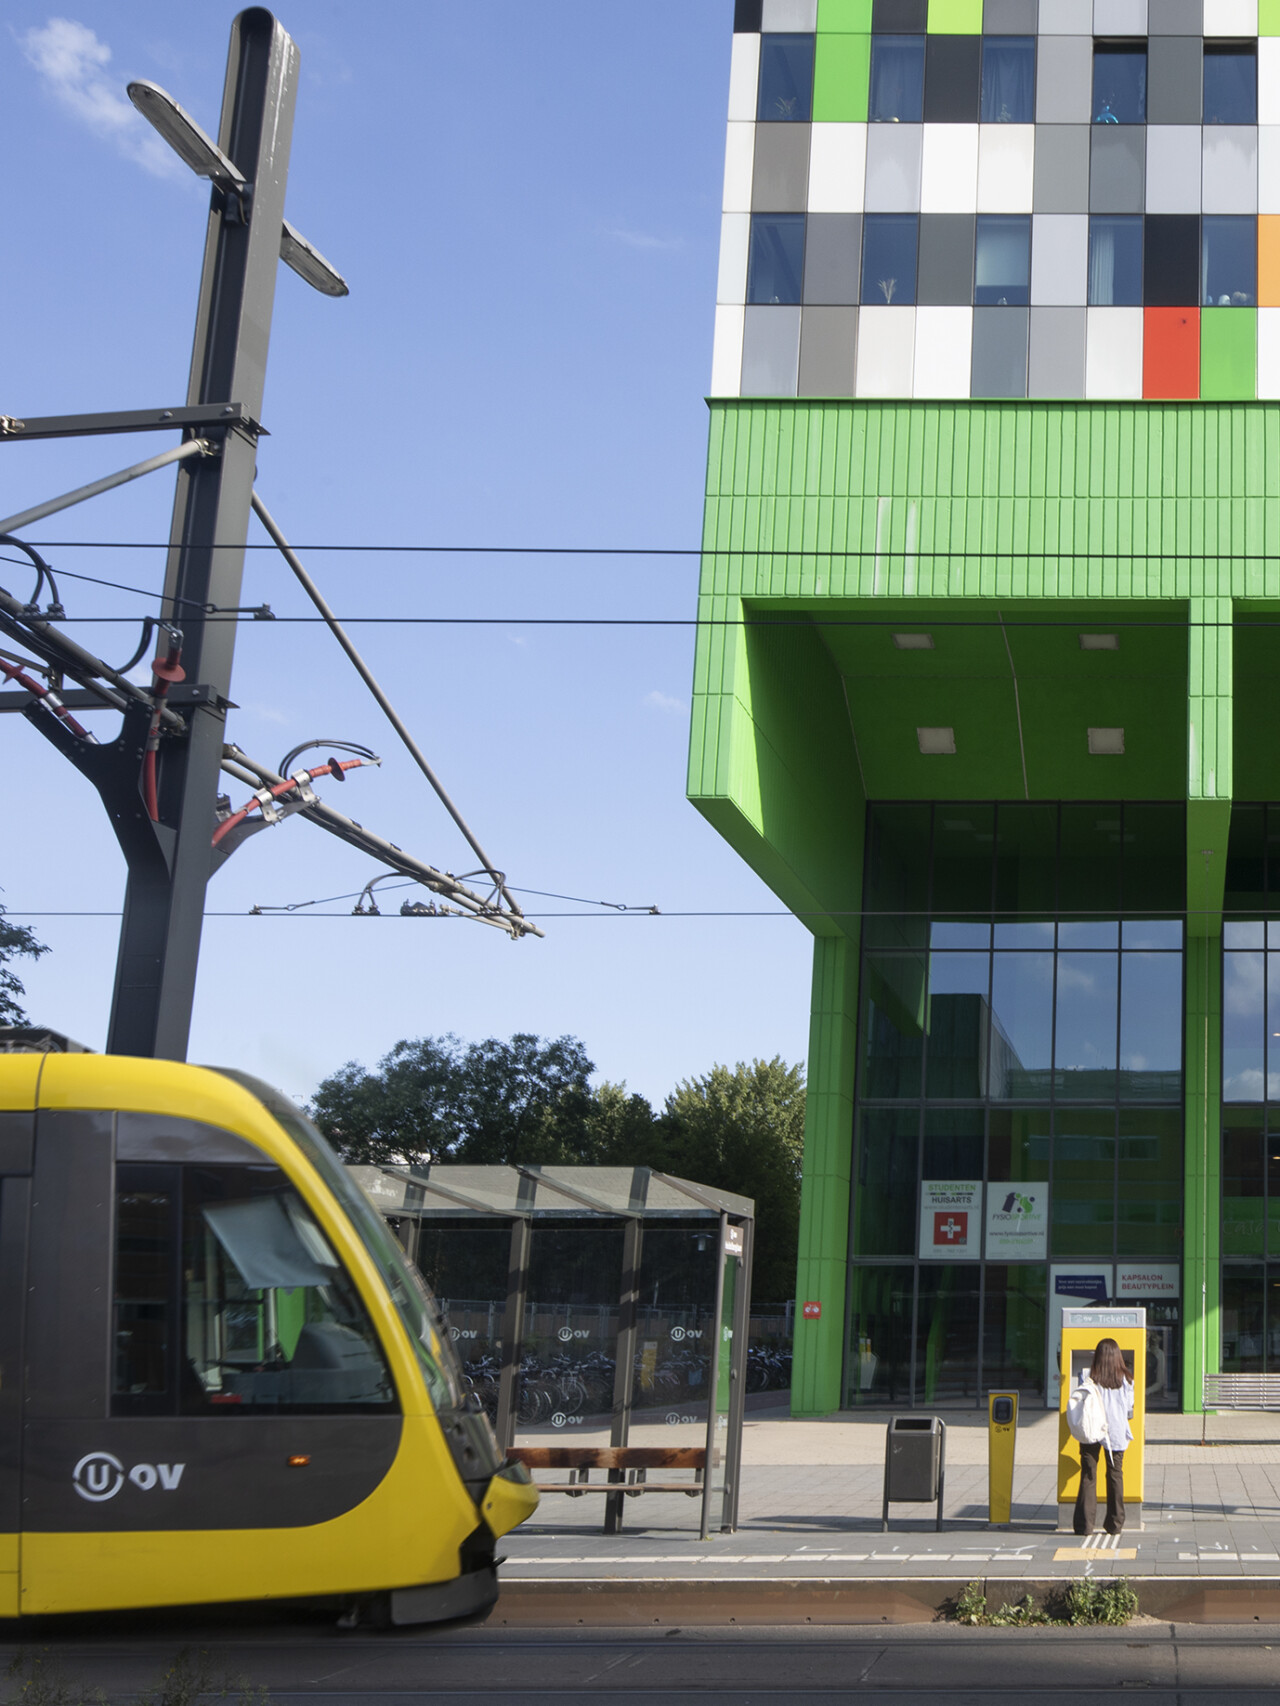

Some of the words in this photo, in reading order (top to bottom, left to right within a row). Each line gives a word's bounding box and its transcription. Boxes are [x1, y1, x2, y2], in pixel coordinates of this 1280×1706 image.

[928, 1184, 976, 1192] STUDENTEN
[931, 1196, 972, 1204] HUISARTS
[1098, 1314, 1129, 1323] Tickets
[127, 1463, 186, 1491] OV
